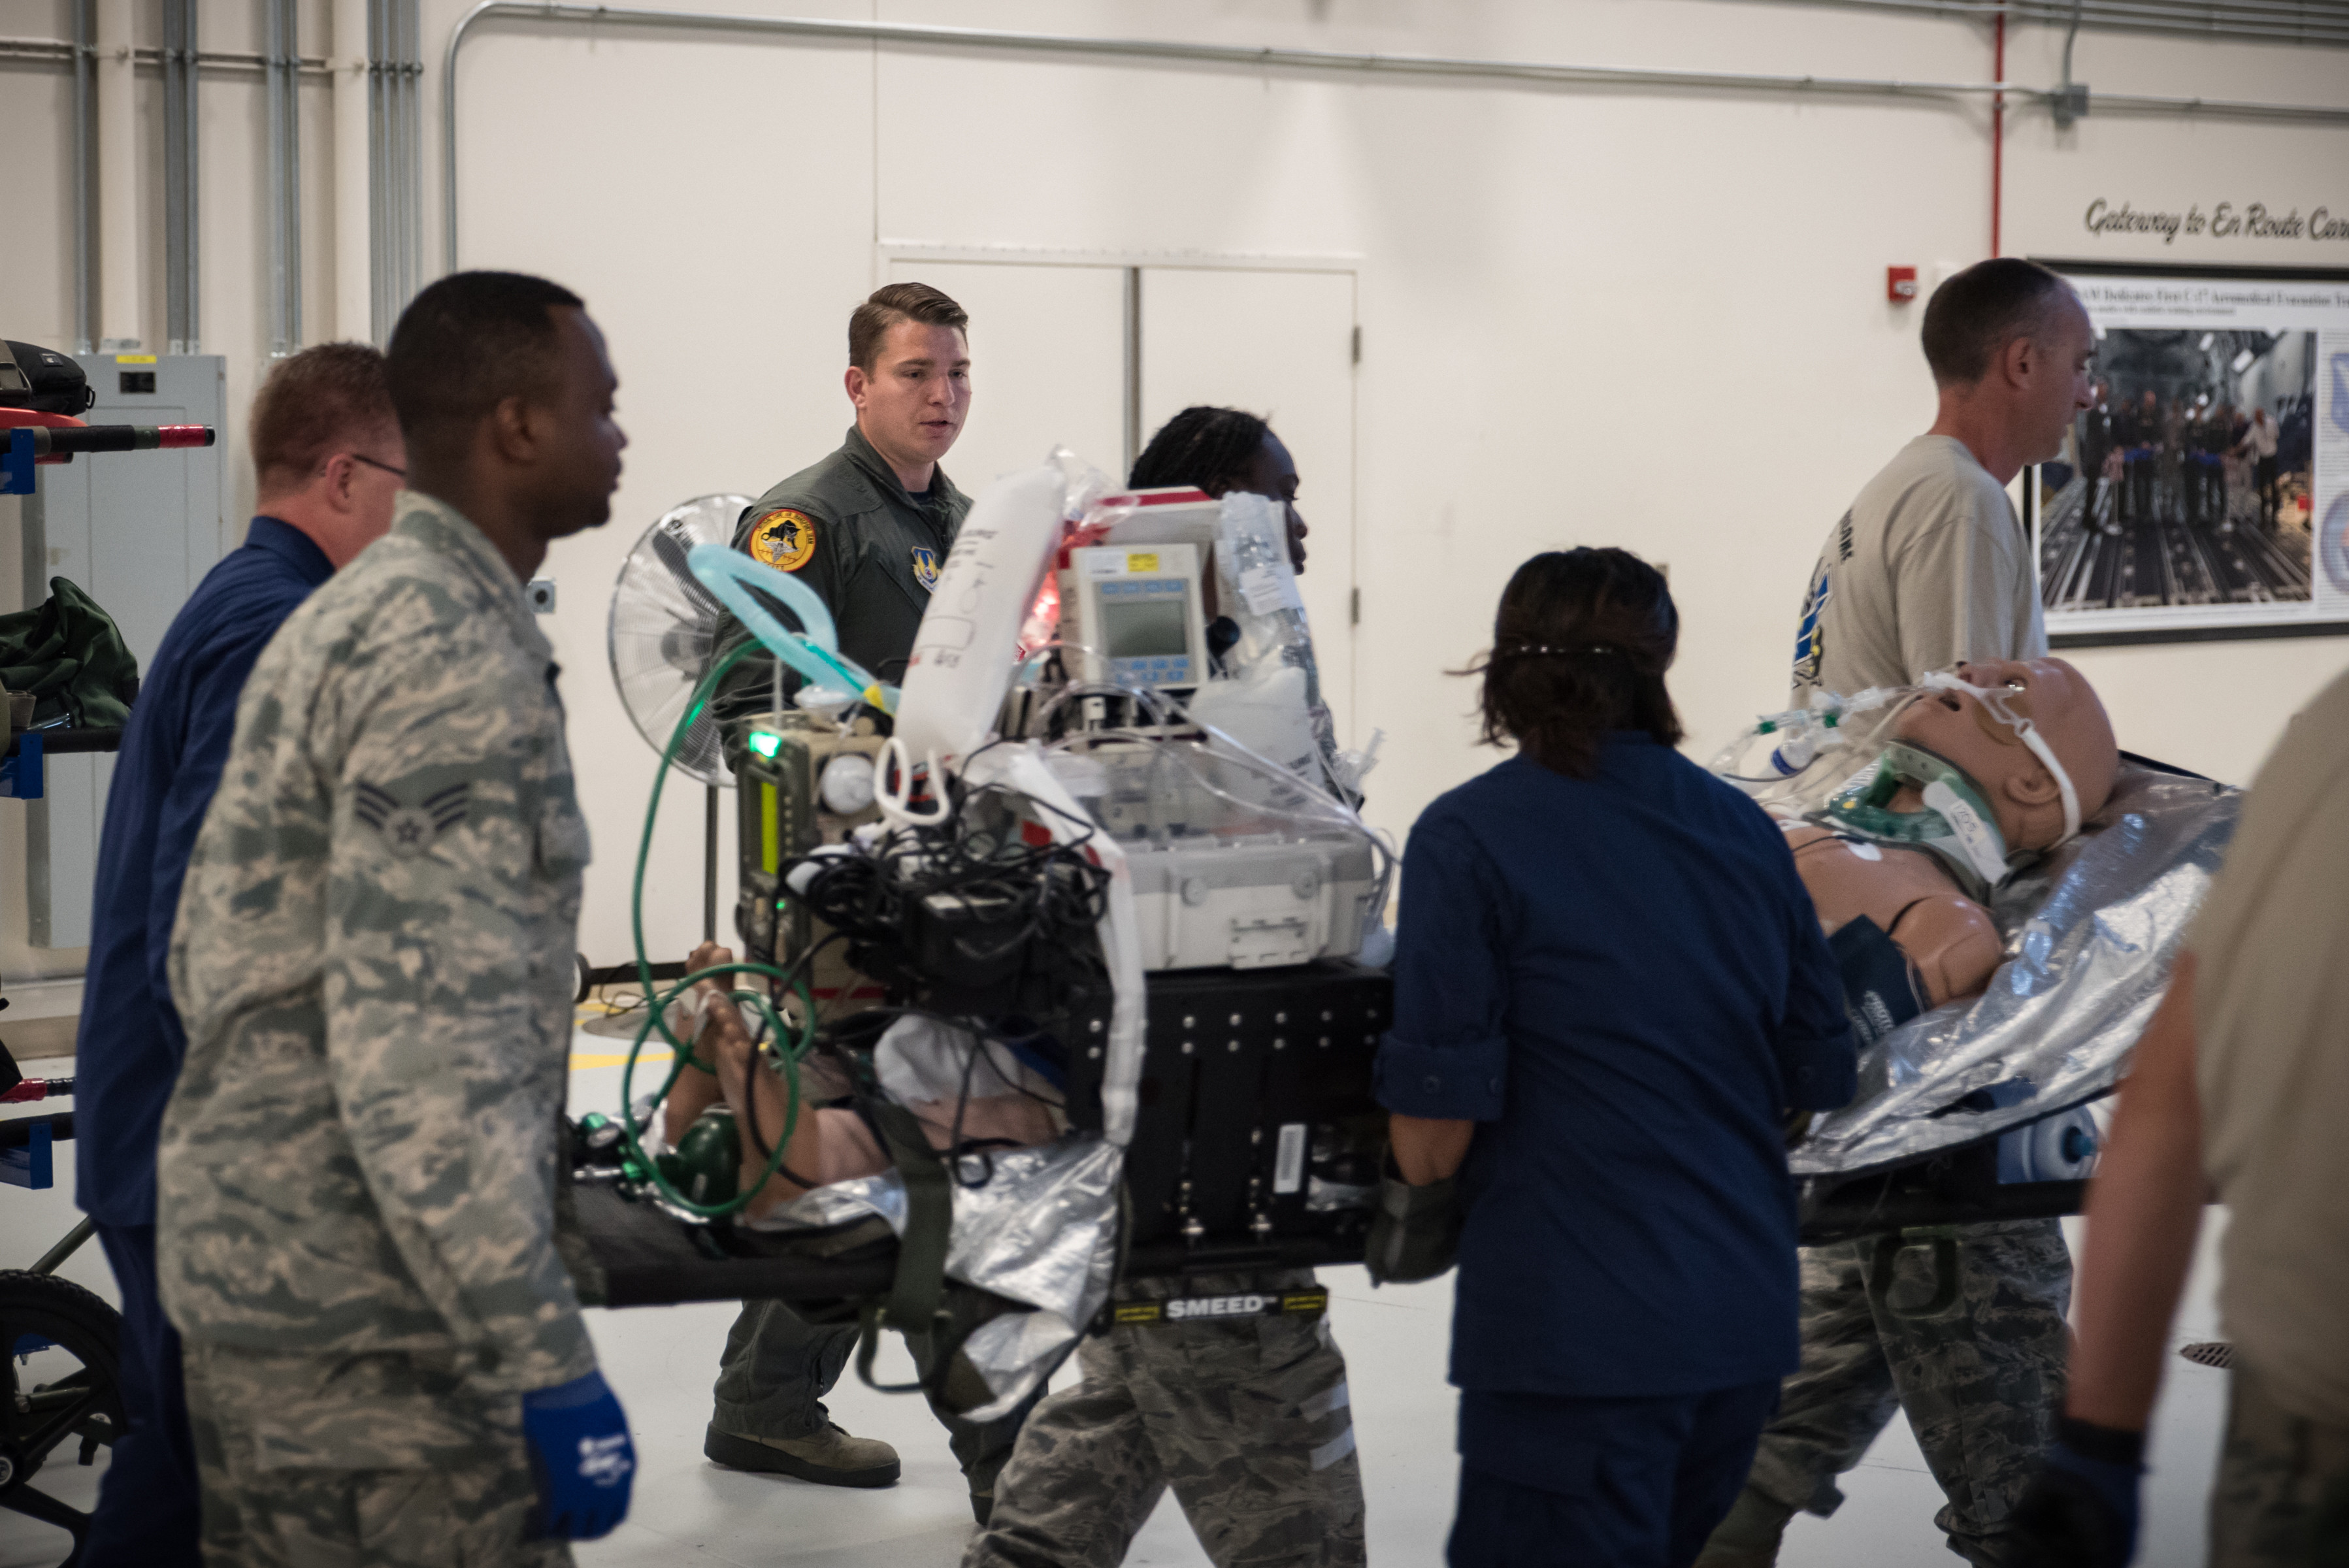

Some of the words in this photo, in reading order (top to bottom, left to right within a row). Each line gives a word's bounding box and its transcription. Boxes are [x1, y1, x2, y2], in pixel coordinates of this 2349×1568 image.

[2086, 197, 2181, 244] Gateway
[2185, 203, 2206, 235] to
[2211, 201, 2241, 237] En
[2246, 202, 2304, 238] Route
[2309, 206, 2349, 241] Car
[1167, 1296, 1263, 1318] SMEED
